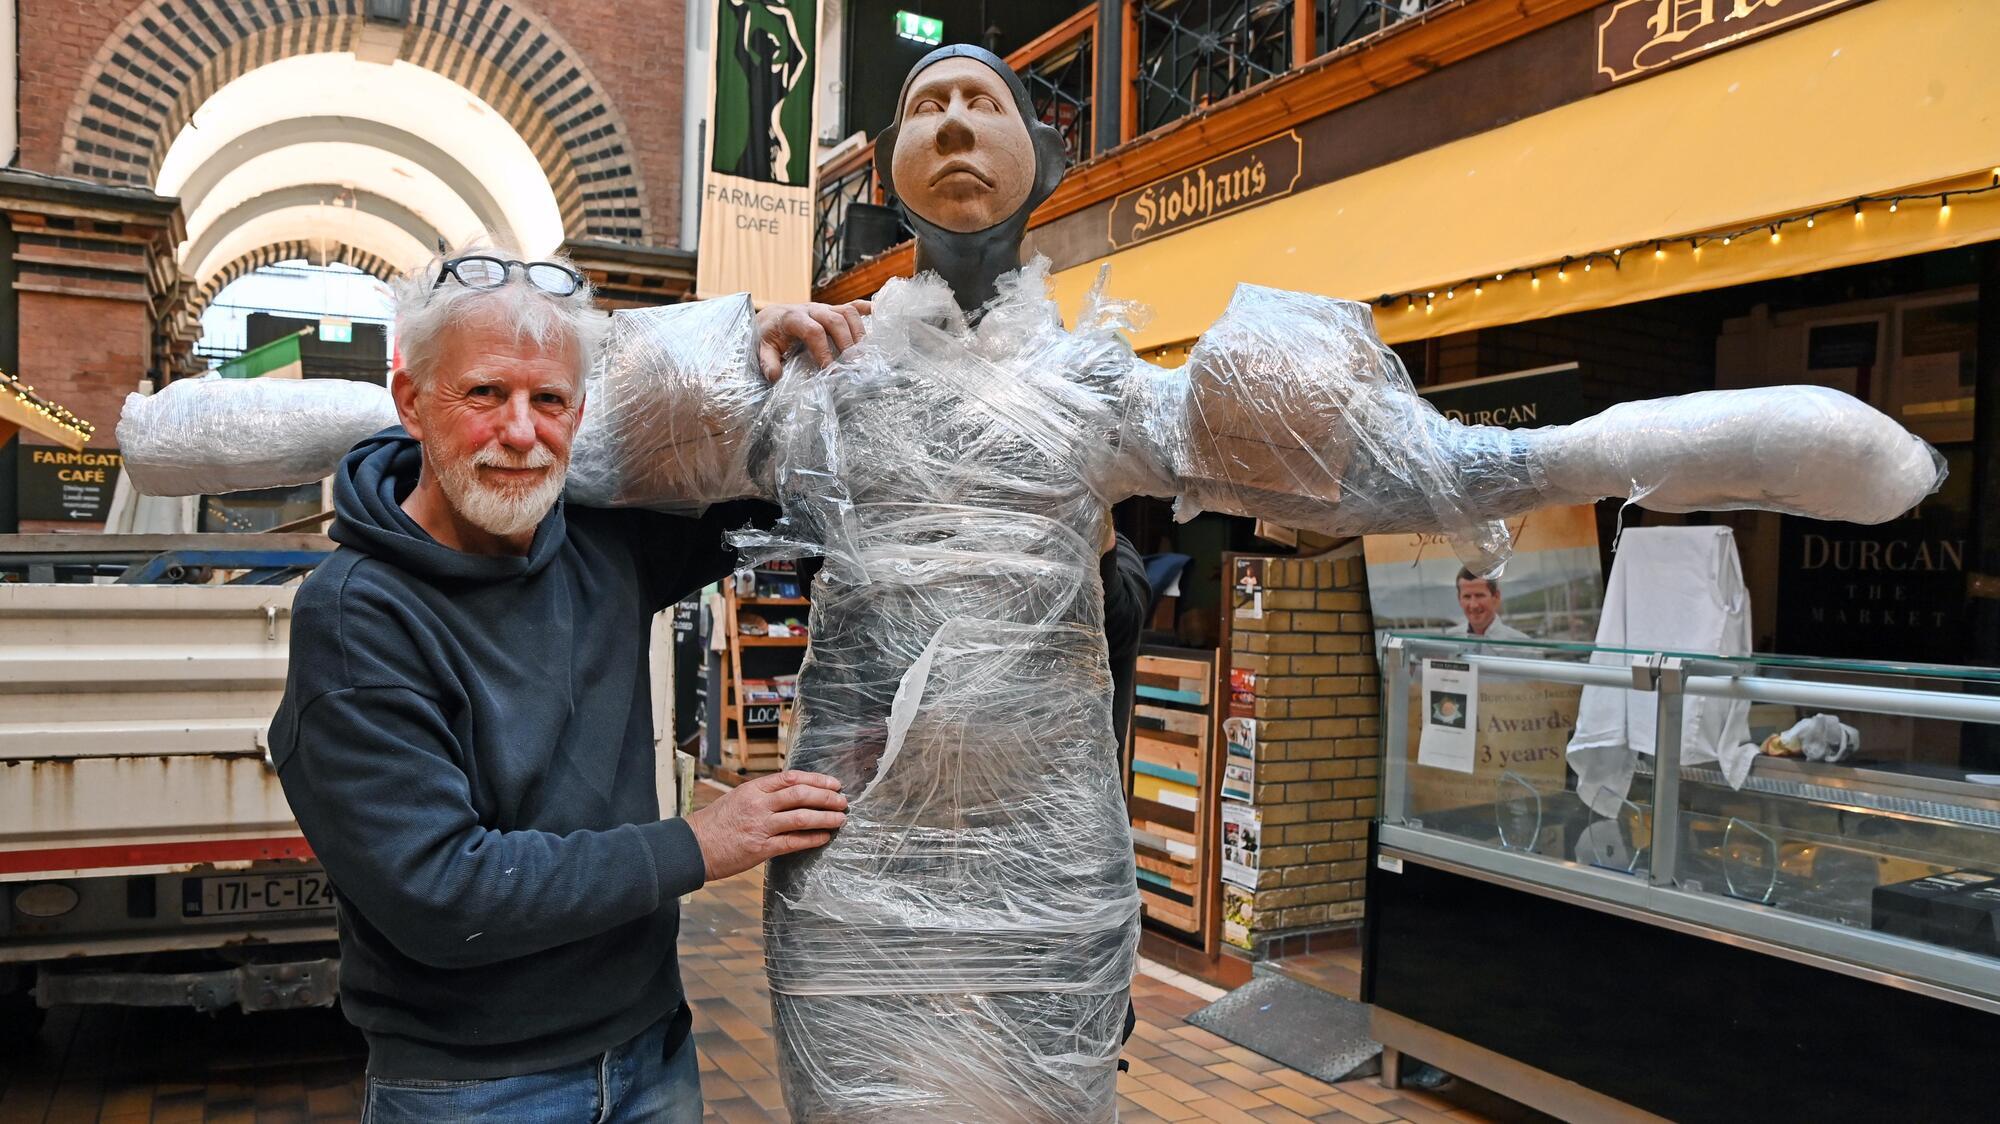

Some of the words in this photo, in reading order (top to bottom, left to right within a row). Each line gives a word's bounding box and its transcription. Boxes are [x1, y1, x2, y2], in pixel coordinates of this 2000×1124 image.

[706, 184, 810, 217] FARMGATE
[1132, 155, 1267, 241] Siobhan's
[736, 214, 780, 236] CAFÉ
[1444, 403, 1537, 426] DURCAN
[57, 468, 105, 483] CAFÉ
[1801, 534, 1967, 571] DURCAN
[1846, 583, 1908, 600] THE
[1811, 607, 1946, 628] MARKET
[1487, 708, 1573, 733] Awards
[1481, 745, 1492, 763] 3
[1499, 744, 1561, 767] years
